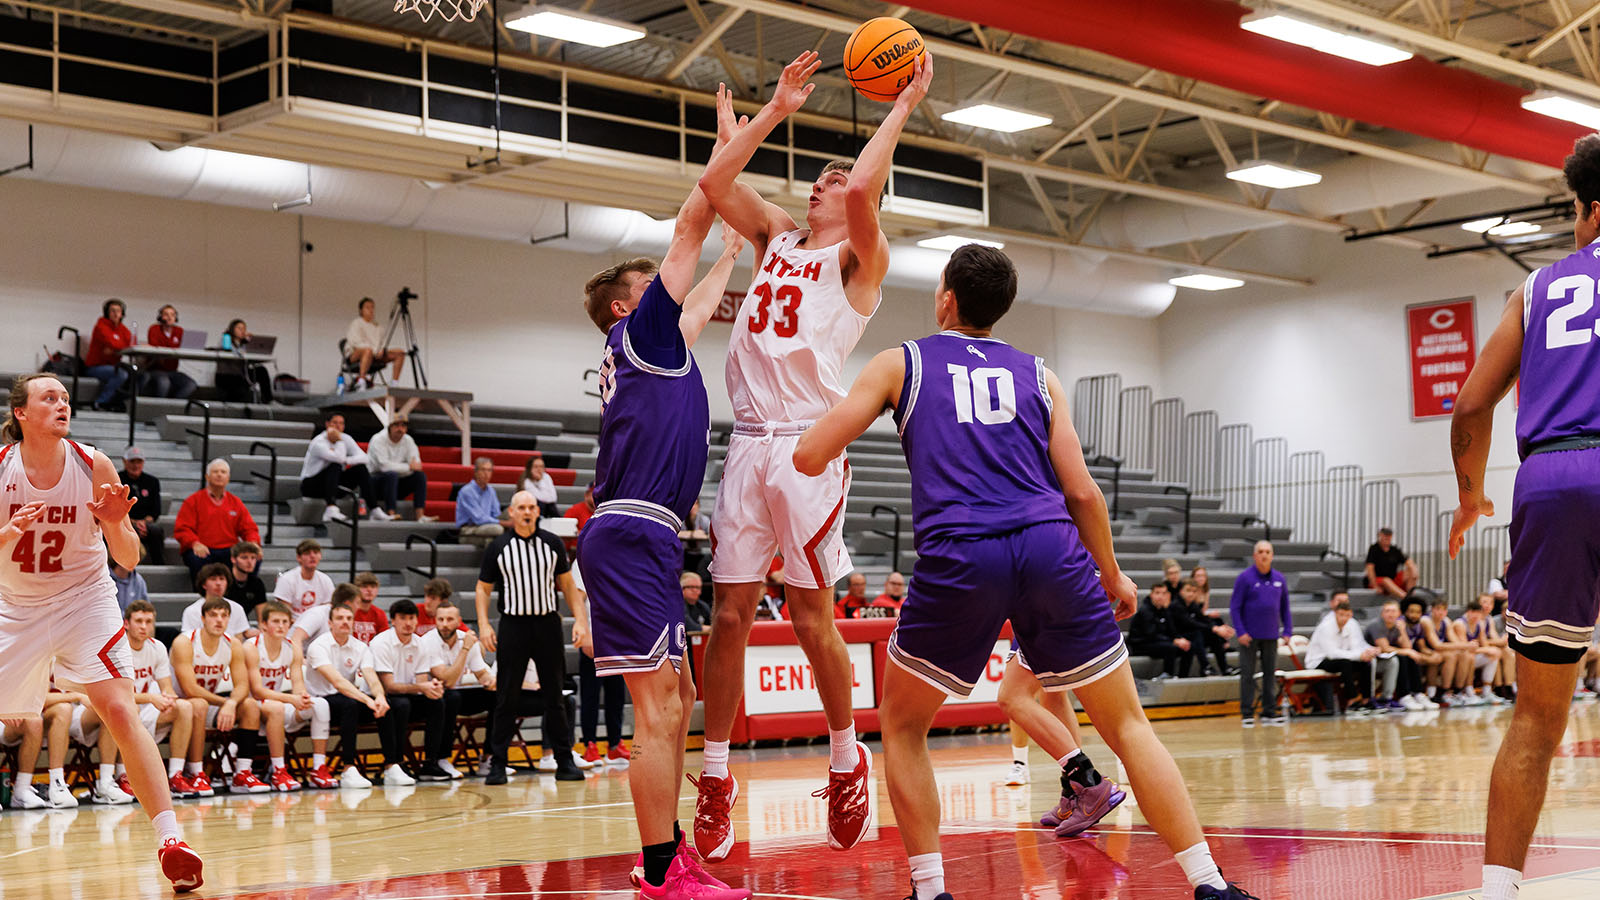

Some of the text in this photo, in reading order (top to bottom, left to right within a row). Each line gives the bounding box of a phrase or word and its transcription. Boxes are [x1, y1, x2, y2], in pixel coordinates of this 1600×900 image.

[871, 38, 921, 70] Wilson
[748, 281, 803, 338] 33
[1546, 274, 1600, 350] 2
[947, 363, 1017, 425] 10
[11, 530, 66, 573] 42
[759, 664, 860, 692] CENTL
